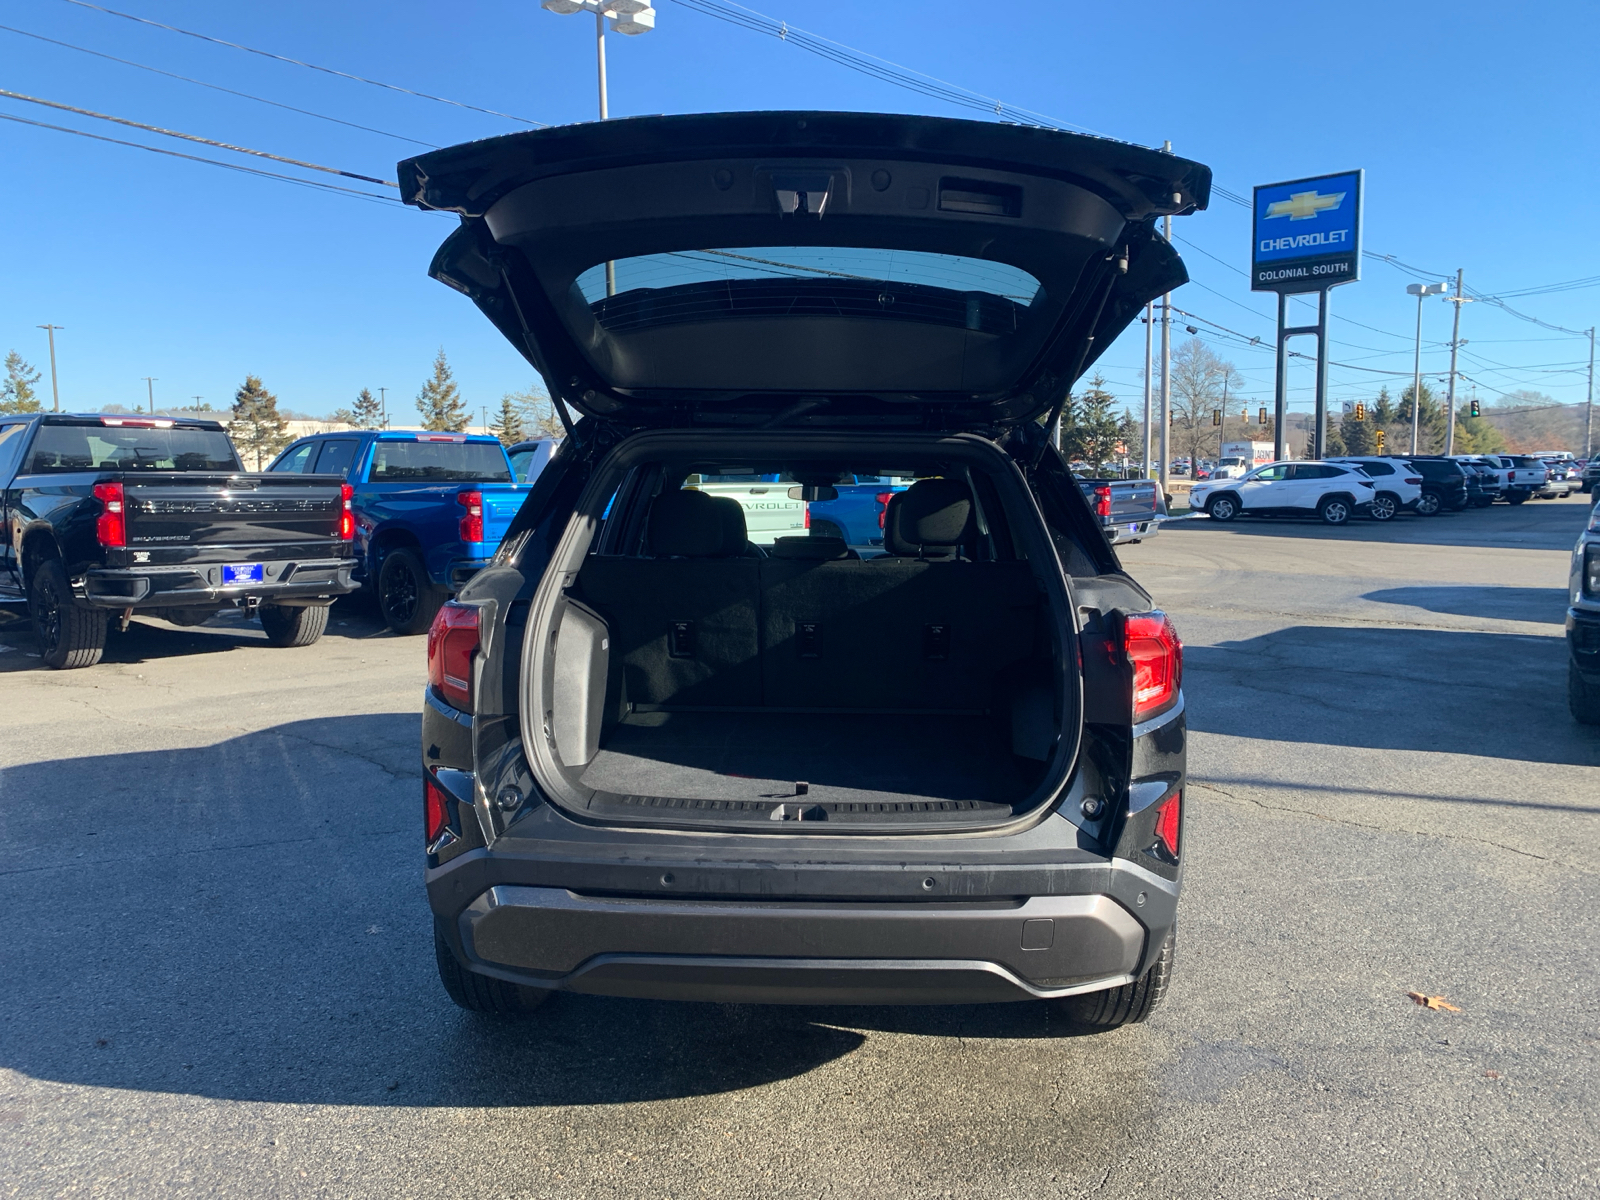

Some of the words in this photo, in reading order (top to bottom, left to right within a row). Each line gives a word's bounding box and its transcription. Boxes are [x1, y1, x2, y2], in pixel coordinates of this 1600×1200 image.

[1260, 229, 1348, 251] CHEVROLET
[1259, 267, 1309, 280] COLONIAL
[1312, 262, 1348, 275] SOUTH
[1255, 450, 1275, 459] LAGUNIT
